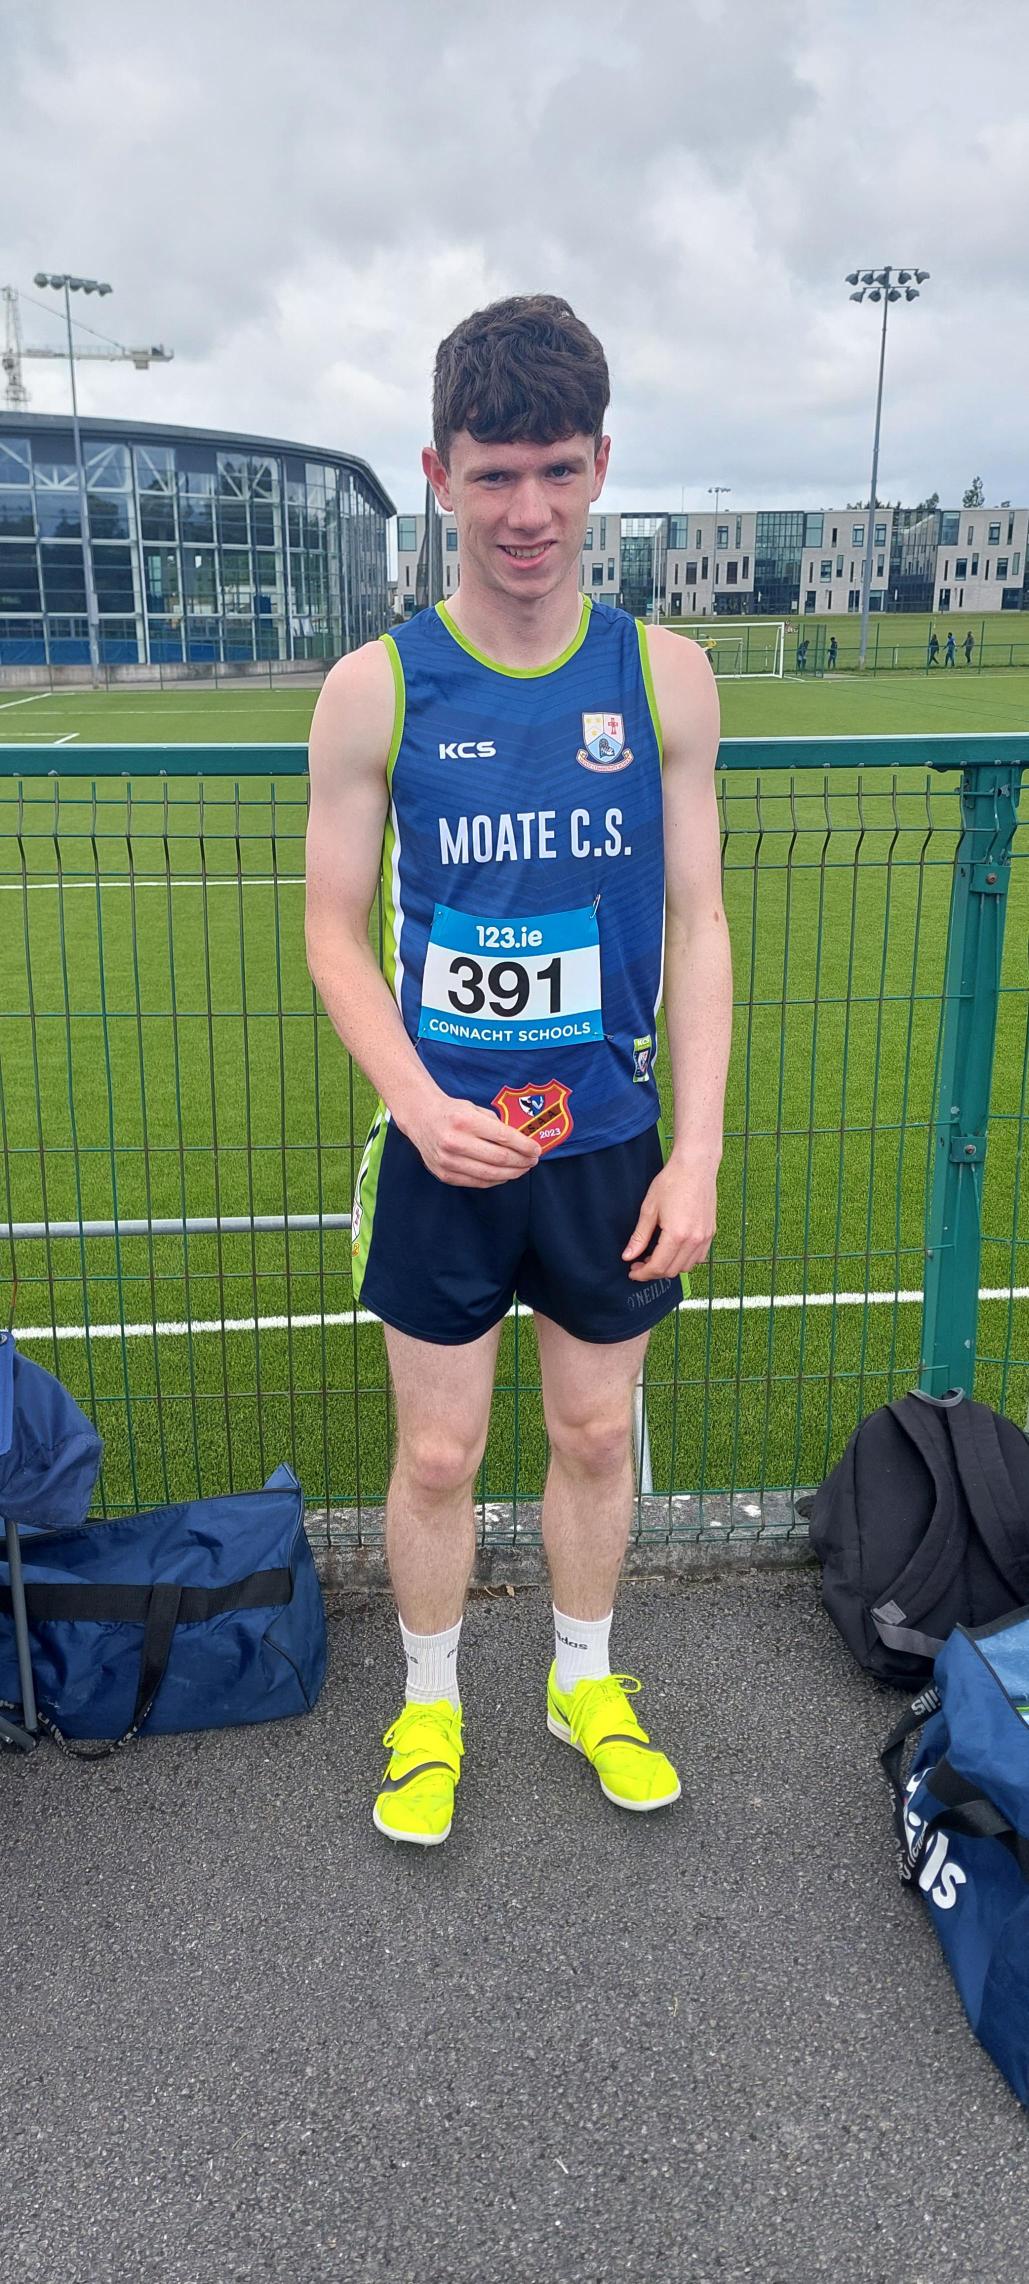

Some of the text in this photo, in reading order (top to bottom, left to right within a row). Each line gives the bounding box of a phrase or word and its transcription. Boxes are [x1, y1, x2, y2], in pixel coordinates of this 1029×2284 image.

[439, 741, 497, 760] KCS
[439, 808, 632, 865] MOATE C.S.
[476, 925, 543, 949] 123.ie
[447, 956, 562, 1018] 391
[429, 1019, 591, 1042] CONNACHT SCHOOLS
[540, 1128, 561, 1139] 2023
